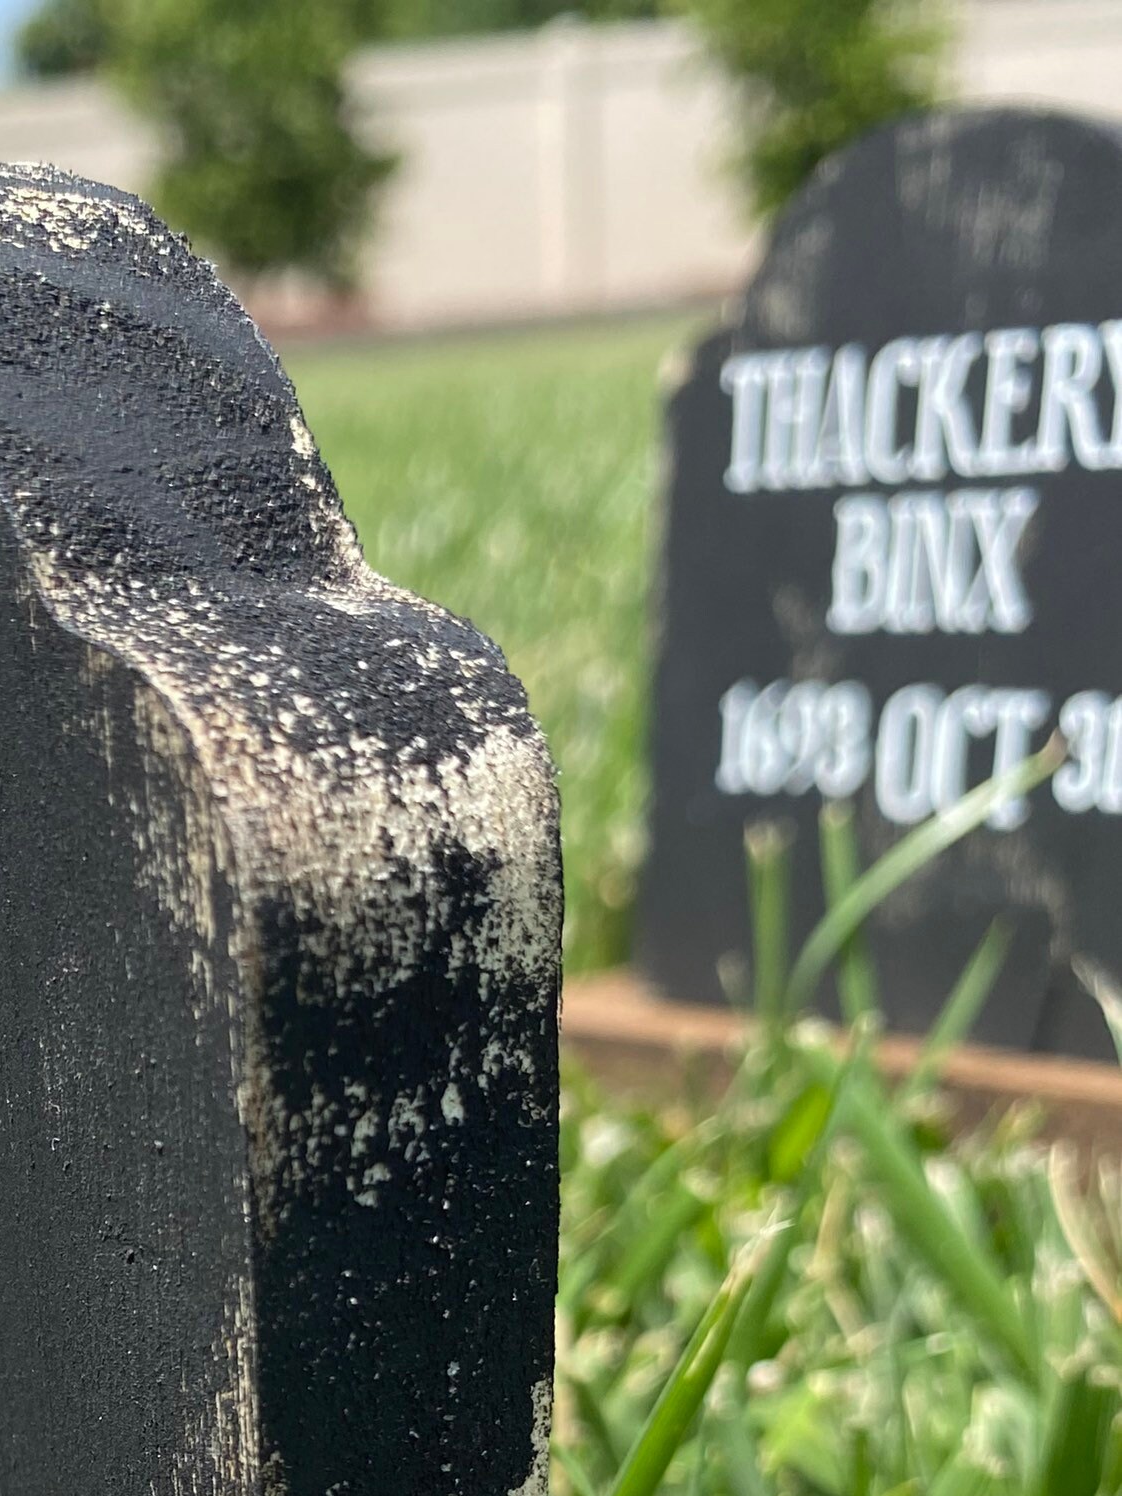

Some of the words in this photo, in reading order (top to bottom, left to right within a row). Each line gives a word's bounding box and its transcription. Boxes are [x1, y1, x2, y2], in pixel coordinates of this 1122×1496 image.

[826, 486, 1041, 635] BINX
[714, 678, 873, 798] 1693
[874, 682, 1051, 832] OCT
